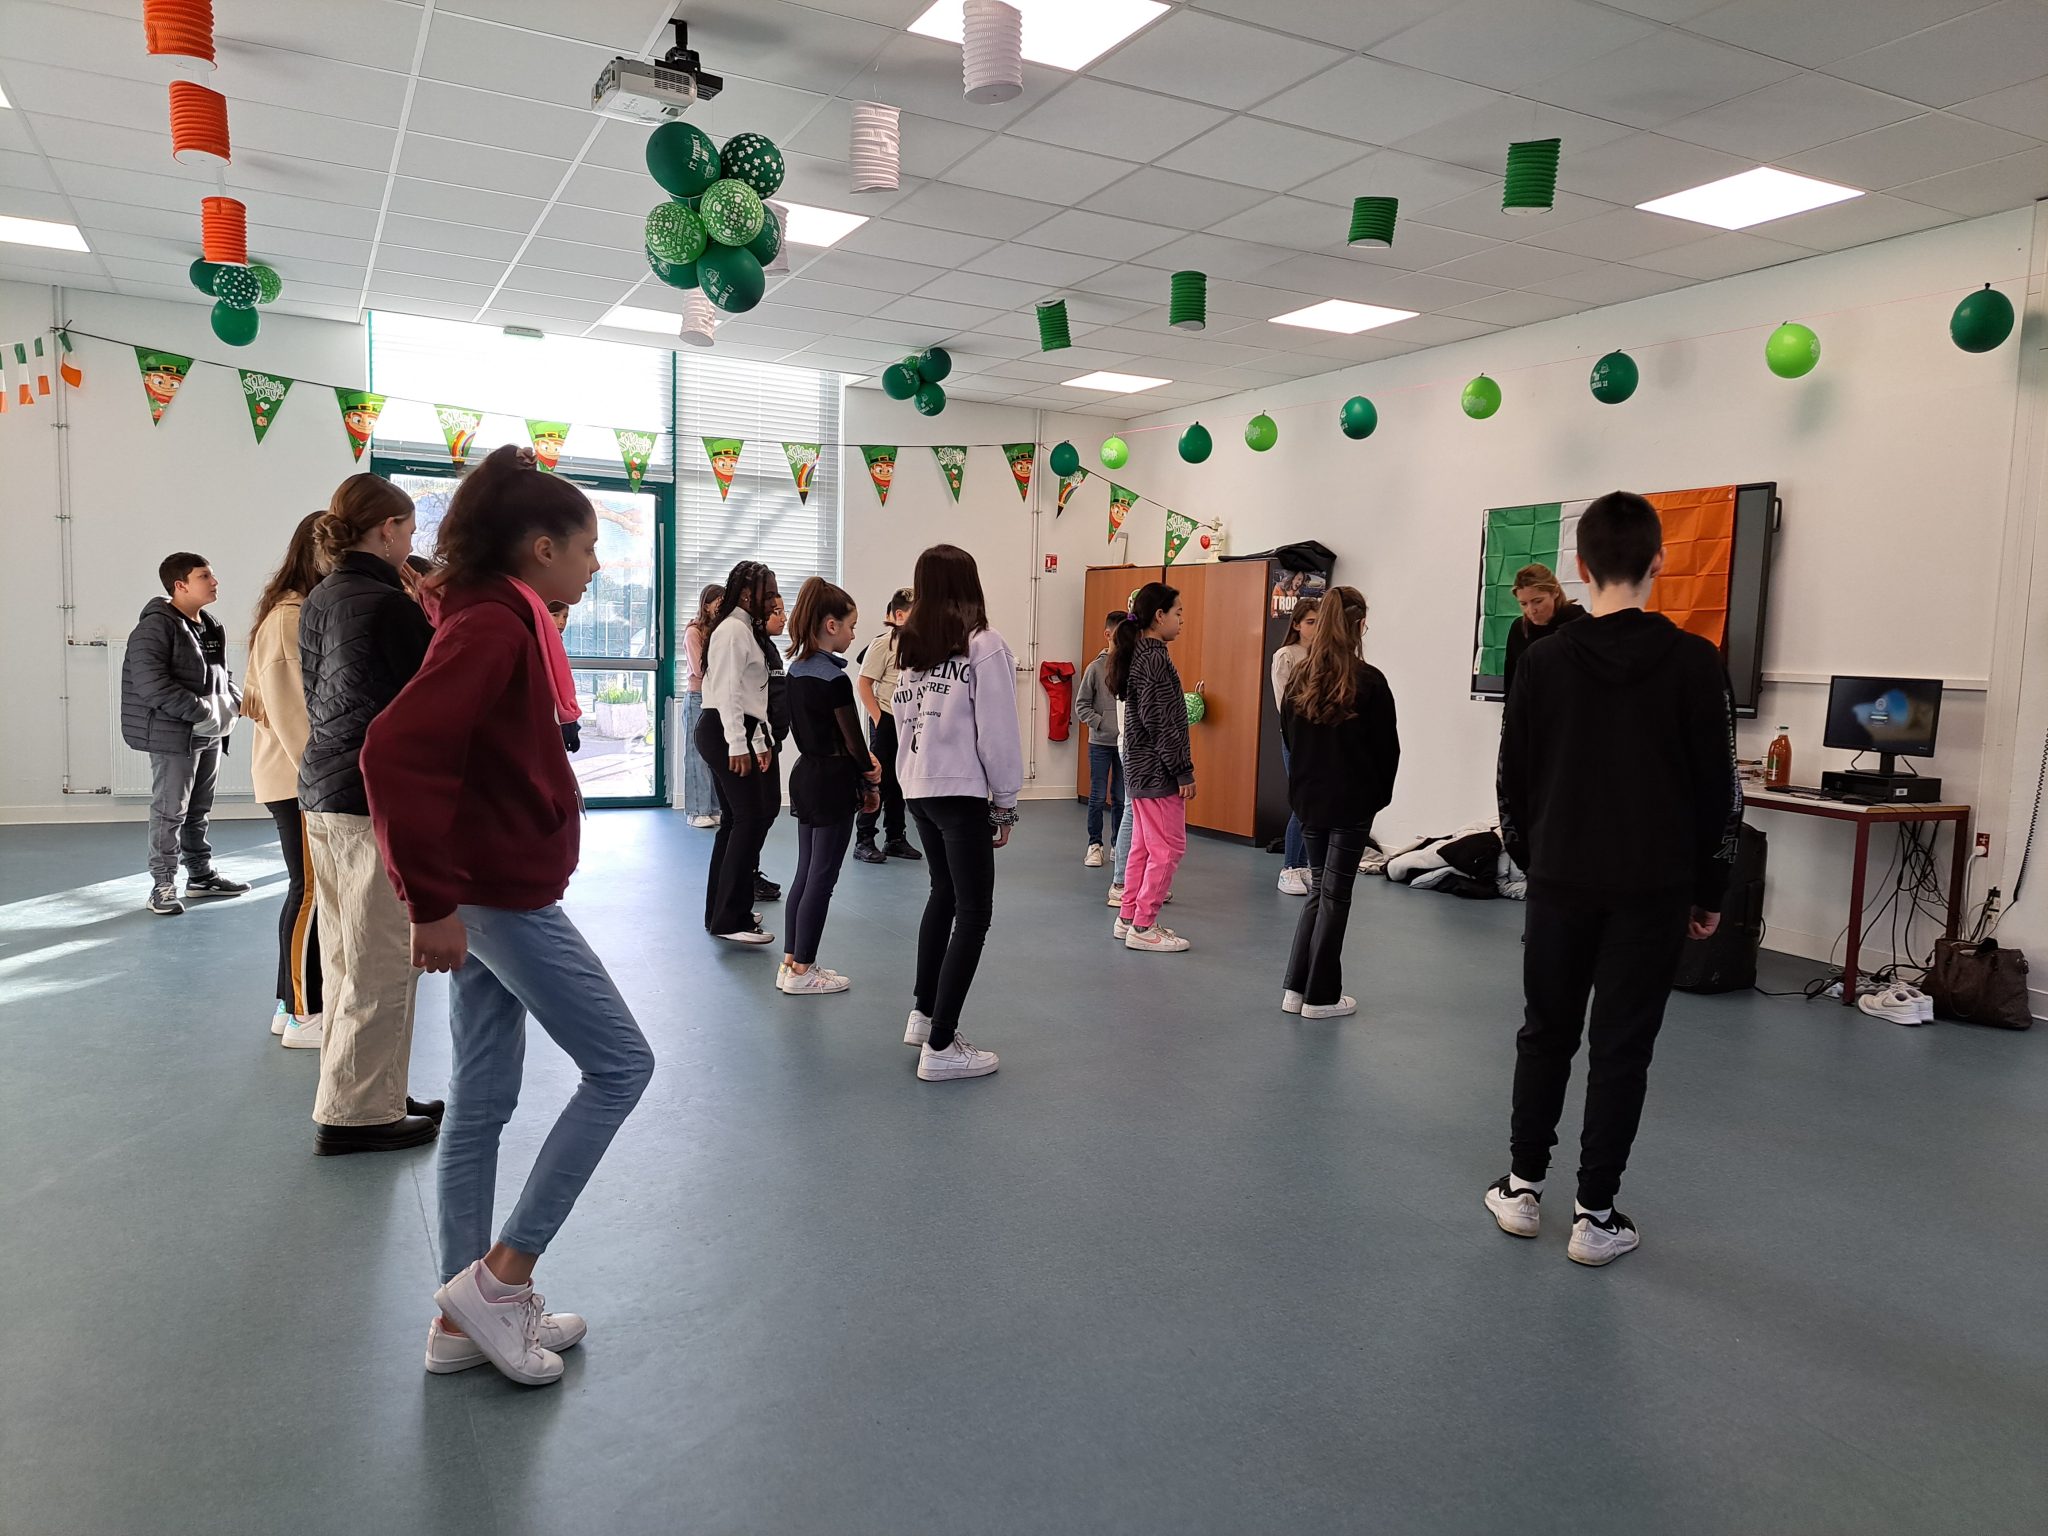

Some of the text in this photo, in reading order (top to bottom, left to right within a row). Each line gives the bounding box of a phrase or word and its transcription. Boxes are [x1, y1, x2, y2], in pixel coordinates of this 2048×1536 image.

[1272, 595, 1298, 611] TROP
[928, 660, 971, 684] EING
[1575, 1231, 1593, 1241] AIR
